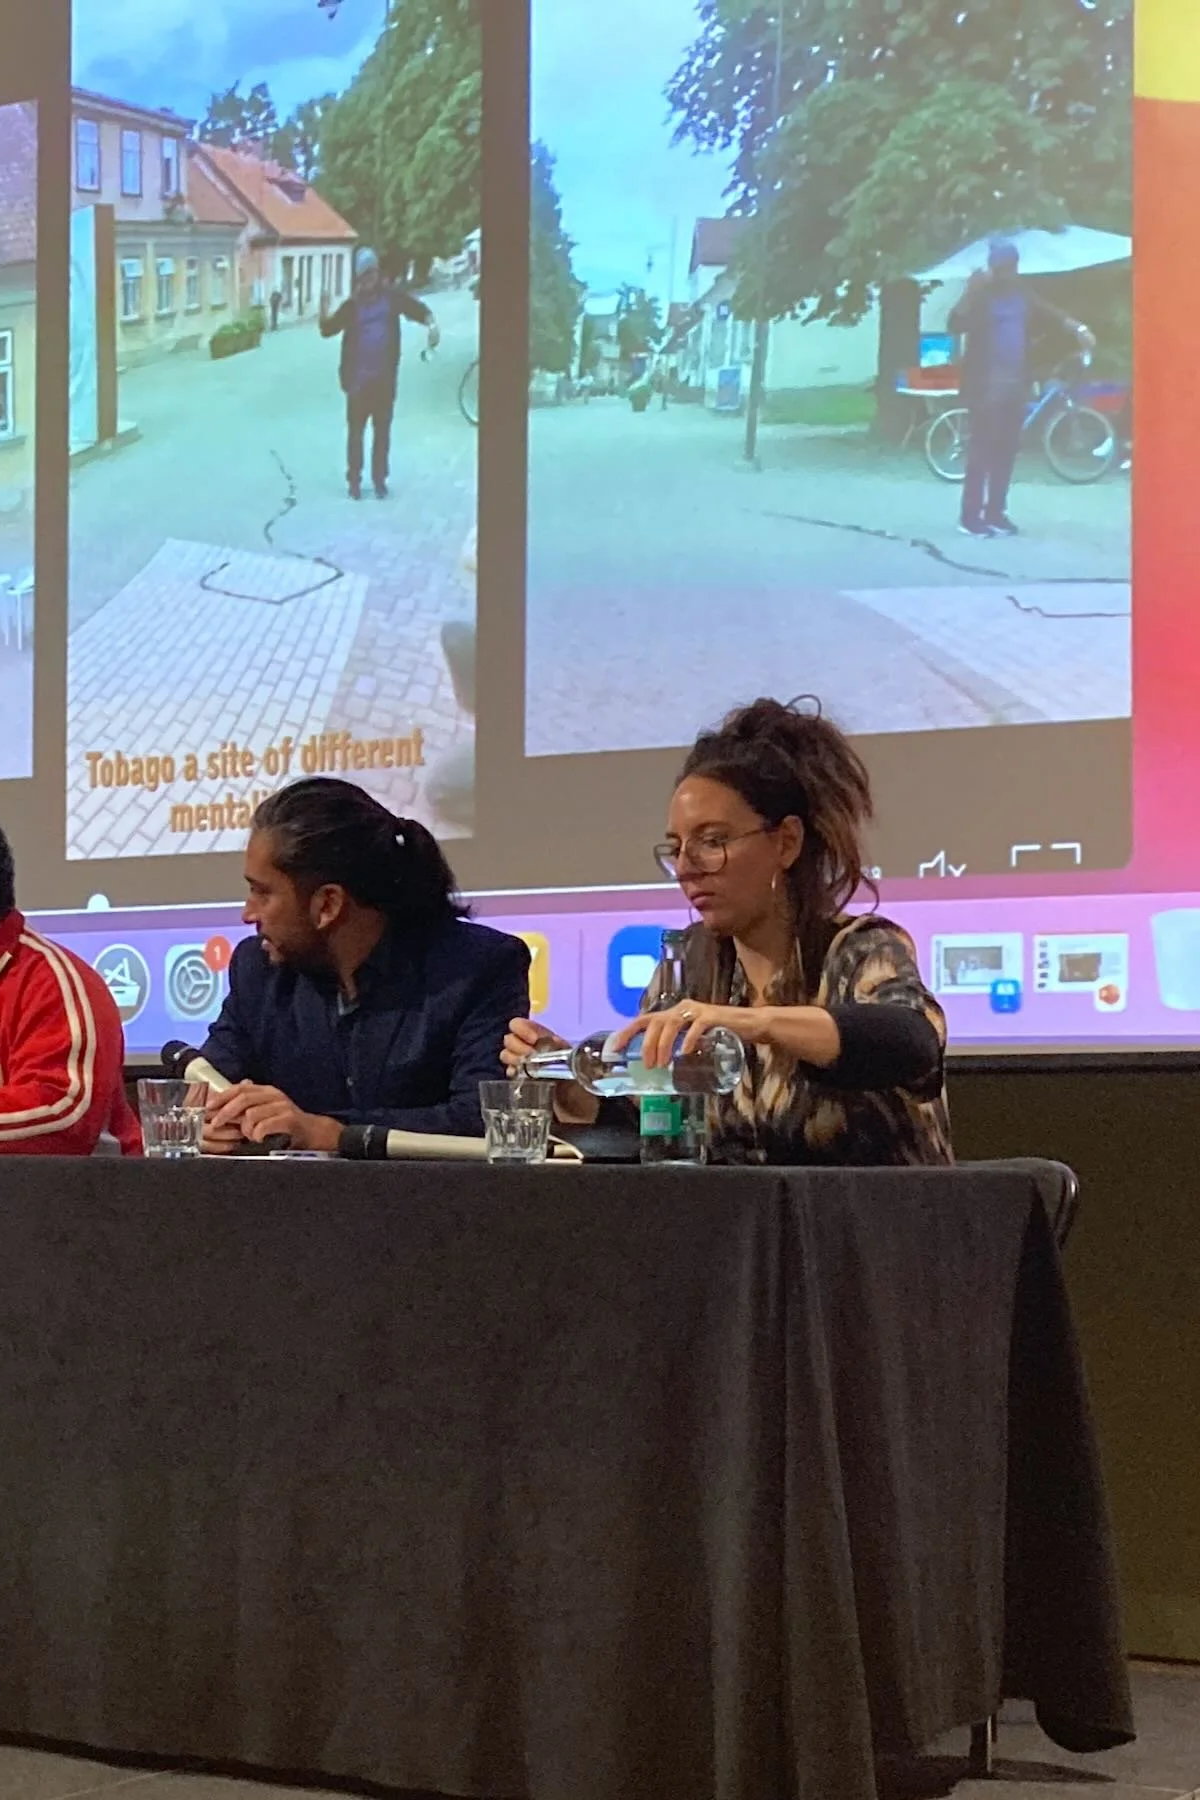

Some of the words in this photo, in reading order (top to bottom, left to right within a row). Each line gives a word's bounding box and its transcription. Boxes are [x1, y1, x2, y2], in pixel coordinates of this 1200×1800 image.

[85, 750, 175, 792] Tobago
[183, 752, 198, 782] a
[207, 741, 255, 780] site
[263, 735, 294, 776] of
[301, 727, 425, 774] different
